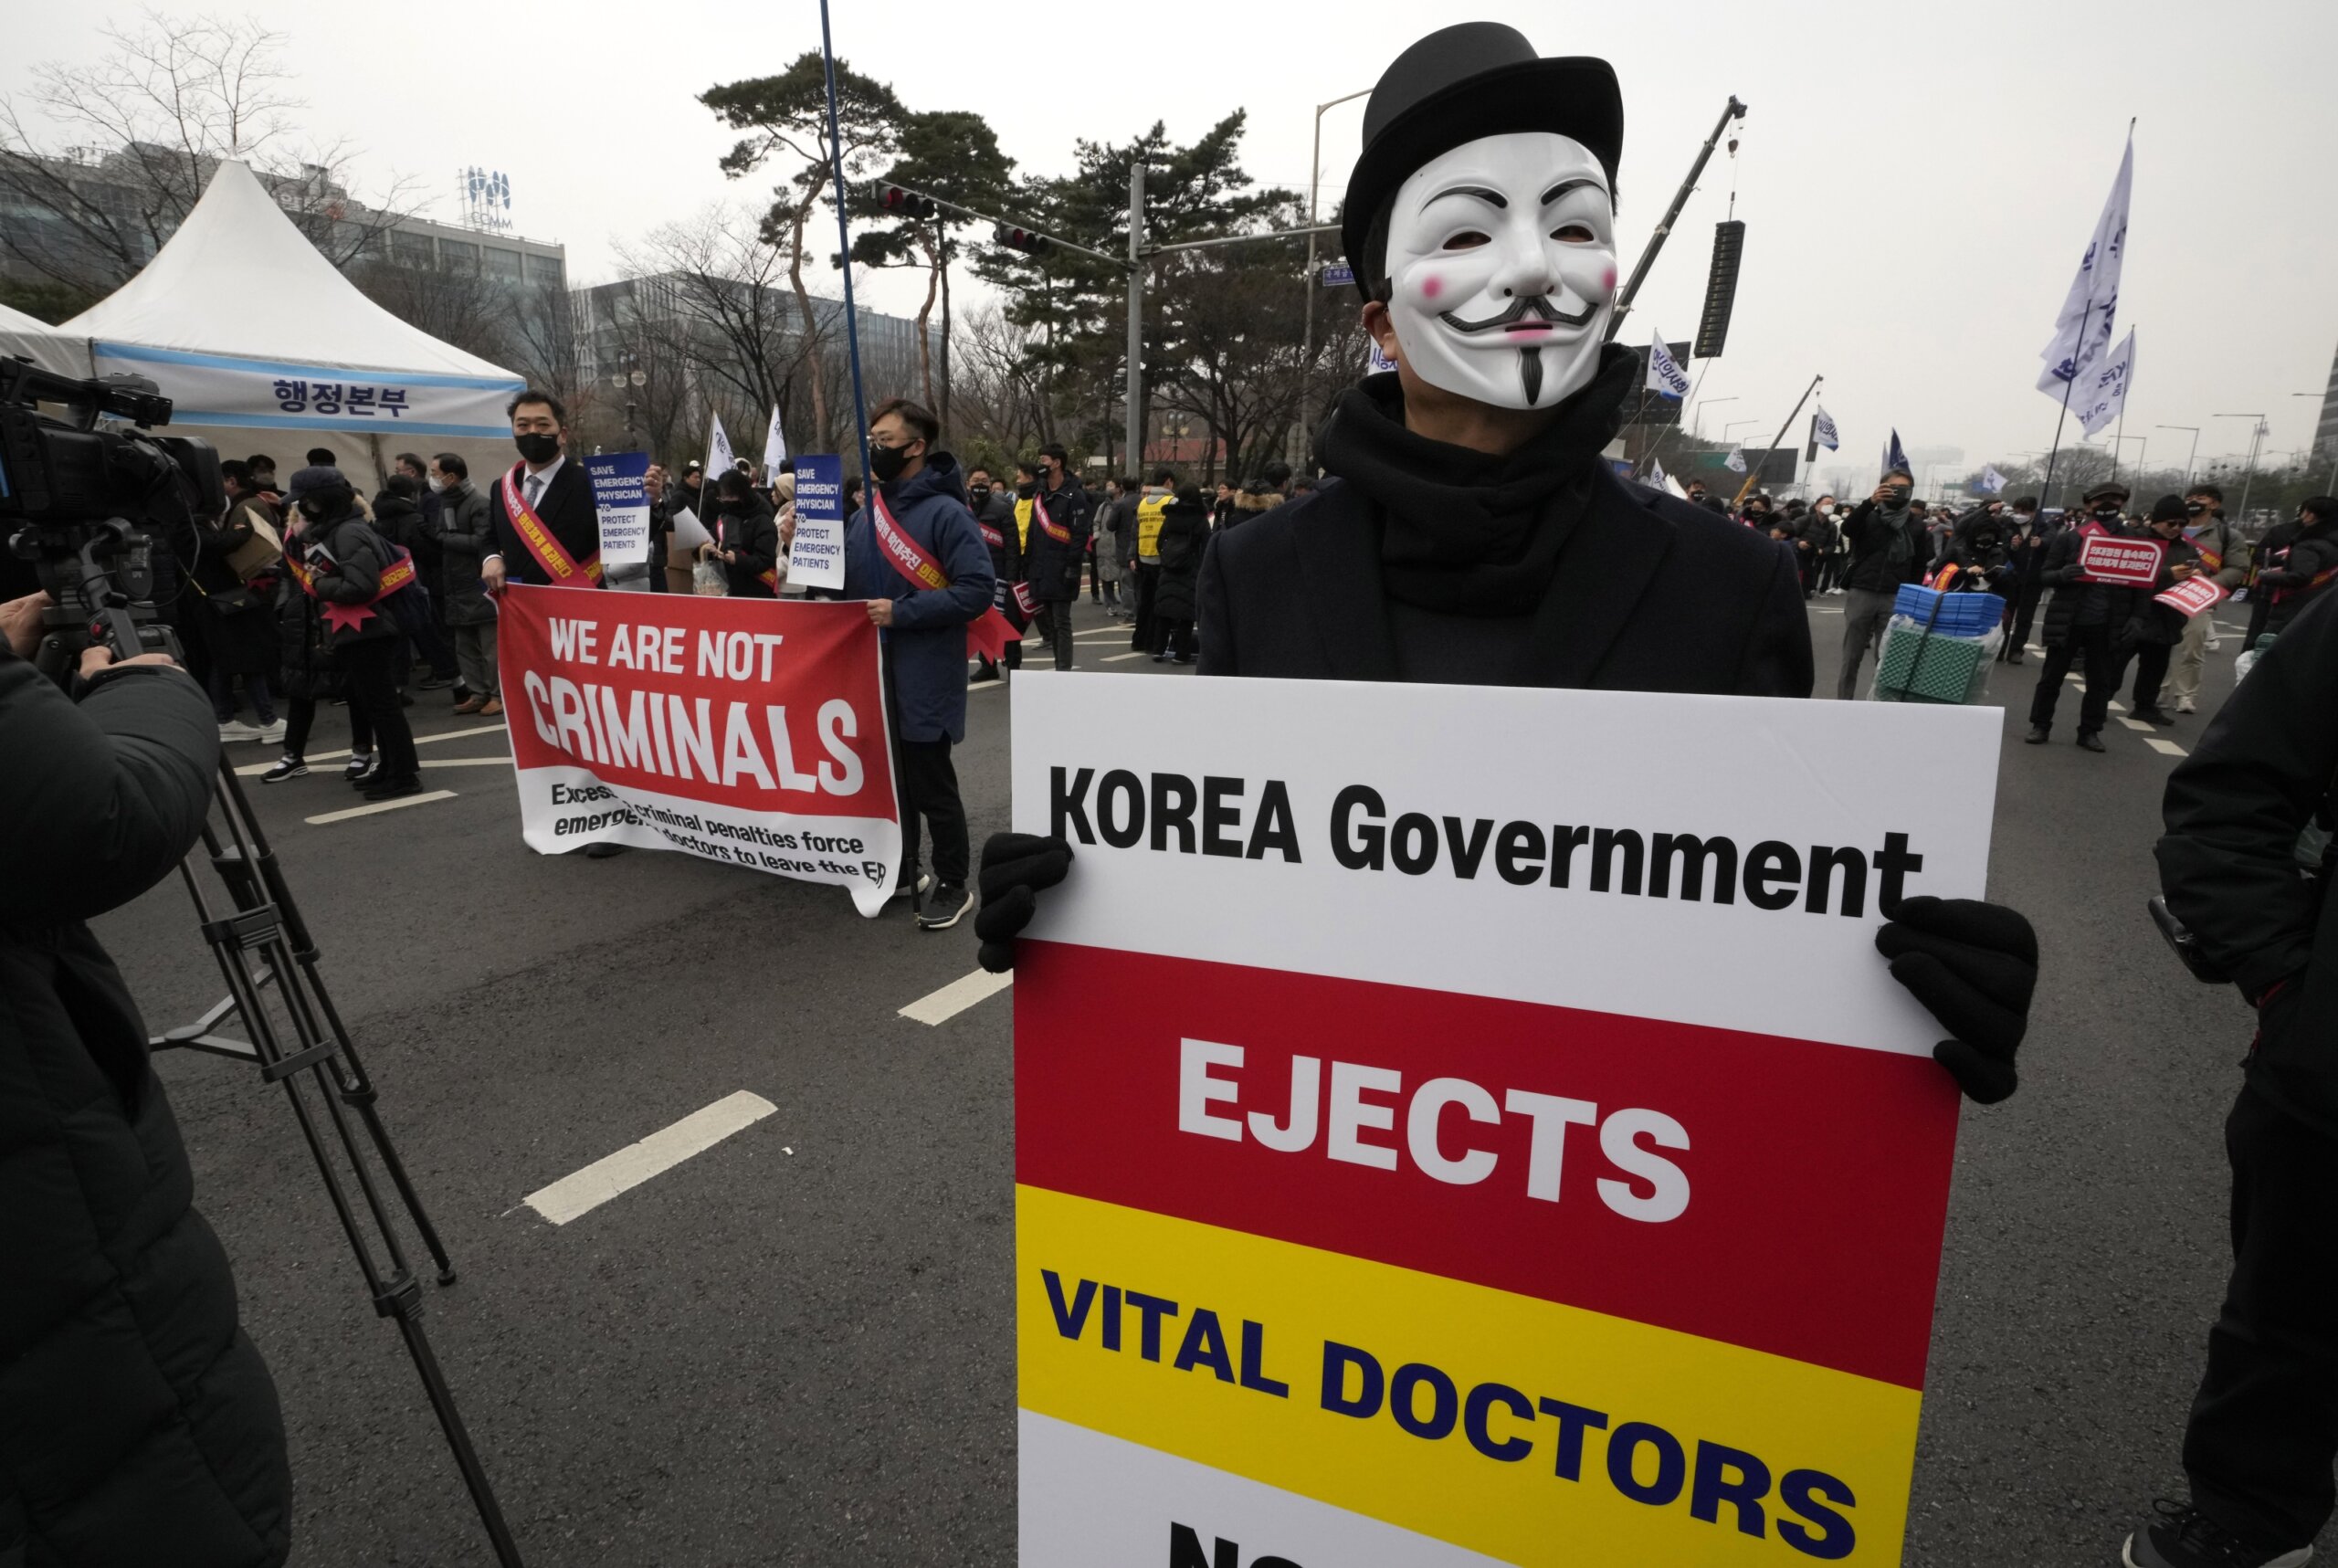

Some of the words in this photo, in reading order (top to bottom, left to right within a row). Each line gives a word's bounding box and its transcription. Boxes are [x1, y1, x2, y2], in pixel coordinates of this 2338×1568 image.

[471, 211, 513, 230] CCMM
[273, 379, 410, 417] 행정본부
[590, 465, 616, 476] SAVE
[796, 468, 816, 480] SAVE
[594, 476, 646, 489] EMERGENCY
[596, 489, 643, 501] PHYSICIAN
[796, 483, 839, 495] EMERGENCY
[599, 503, 612, 512] TO
[795, 499, 836, 510] PHYSICIAN
[601, 514, 637, 525] PROTECT
[796, 512, 807, 523] TO
[603, 526, 647, 538] EMERGENCY
[795, 528, 830, 540] PROTECT
[603, 540, 636, 550] PATIENTS
[794, 542, 841, 554] EMERGENCY
[887, 531, 922, 571] 확대추진
[792, 556, 830, 570] PATIENTS
[548, 616, 598, 666] WE
[608, 624, 687, 675] ARE
[697, 629, 784, 683] NOT
[523, 669, 865, 796] CRIMINALS
[634, 804, 703, 832] criminal
[705, 819, 799, 849] penalties
[801, 831, 865, 854] force
[1050, 765, 1301, 864] KOREA
[1329, 784, 1923, 919] Government
[663, 827, 732, 860] doctors
[733, 846, 757, 866] to
[758, 851, 817, 873] leave
[817, 859, 860, 876] the
[861, 861, 886, 889] ER
[1178, 1037, 1691, 1225] EJECTS
[1040, 1268, 1290, 1399] VITAL
[1321, 1340, 1857, 1561] DOCTORS
